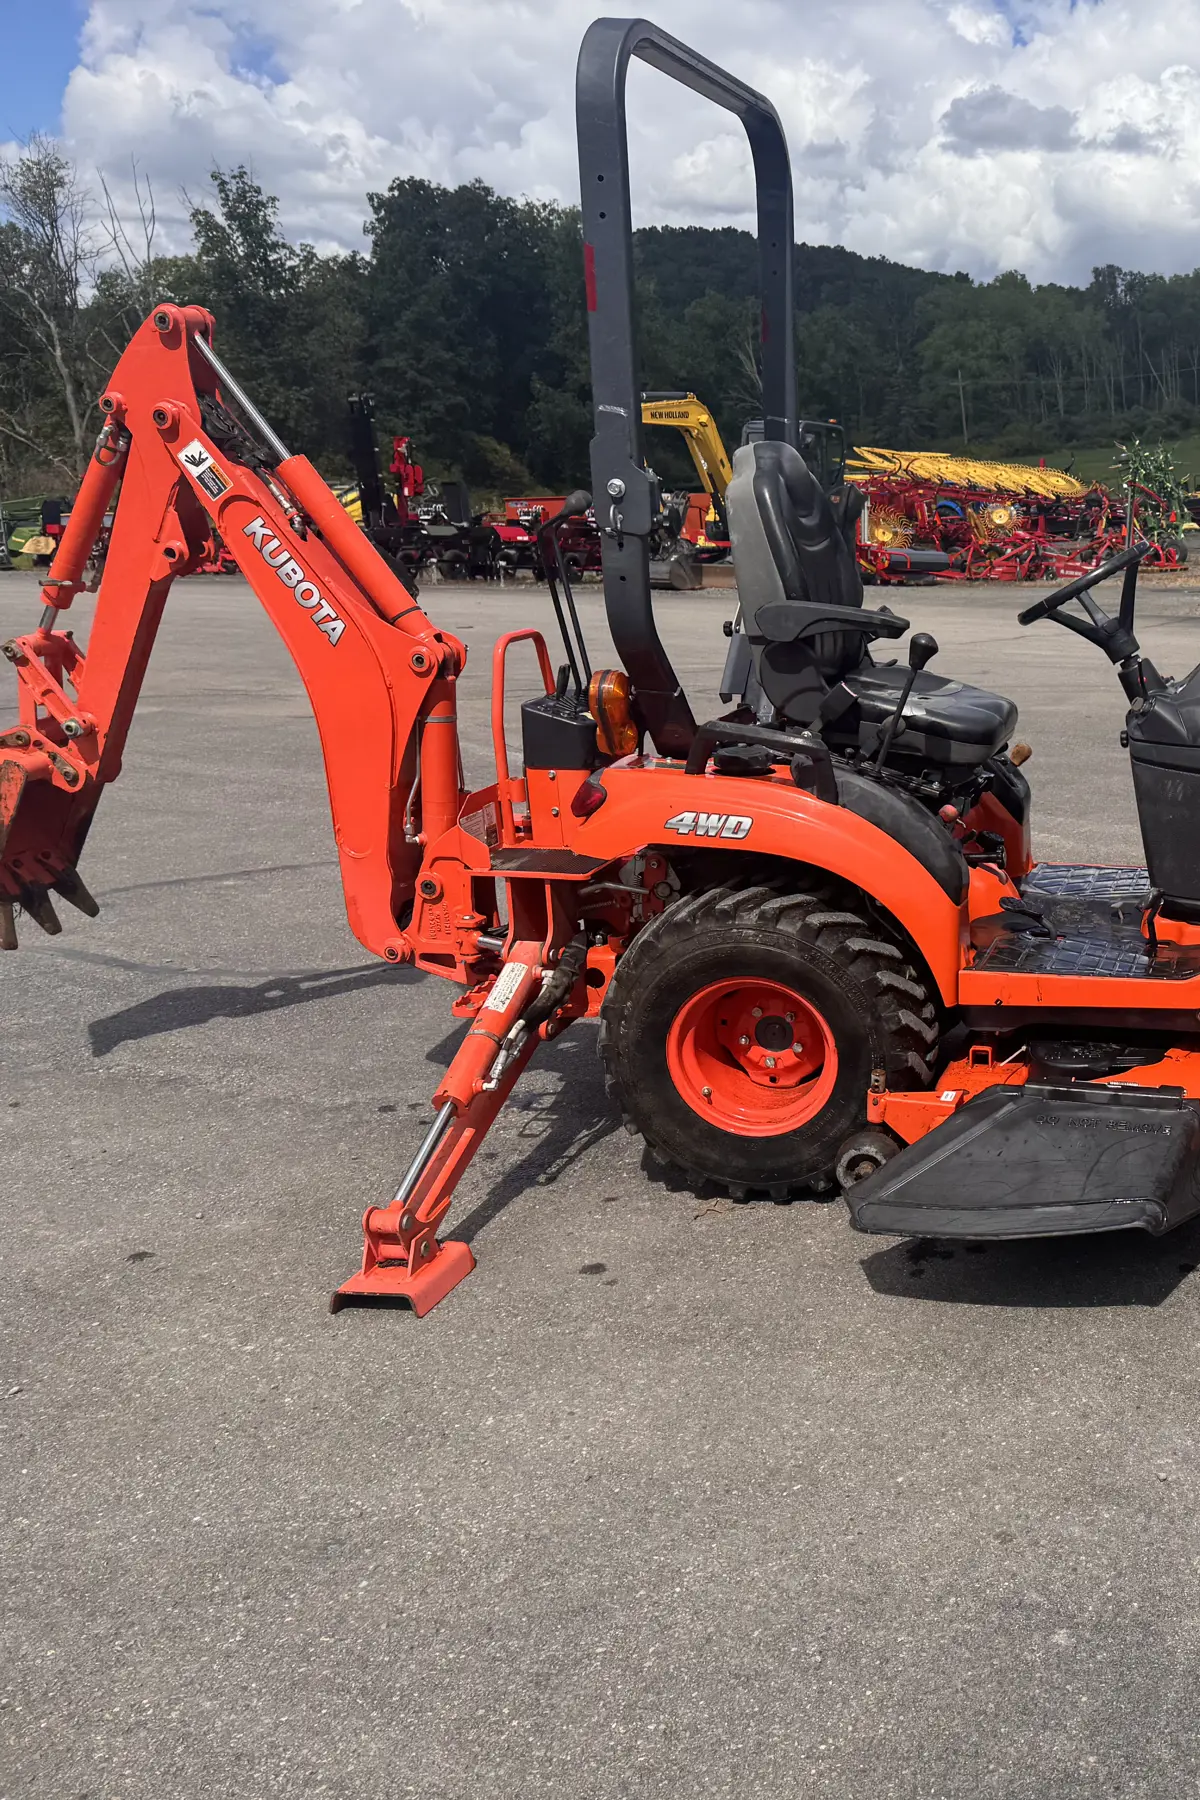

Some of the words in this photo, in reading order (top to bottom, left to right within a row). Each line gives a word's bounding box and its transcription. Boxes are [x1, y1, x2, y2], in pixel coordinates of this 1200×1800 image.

[650, 411, 663, 419] NEW
[664, 411, 690, 419] HOLLAND
[242, 515, 346, 648] KUBOTA
[664, 811, 754, 839] 4WD
[1036, 1114, 1060, 1126] DO
[1068, 1117, 1101, 1128] NOT
[1106, 1120, 1173, 1136] REMOVE
